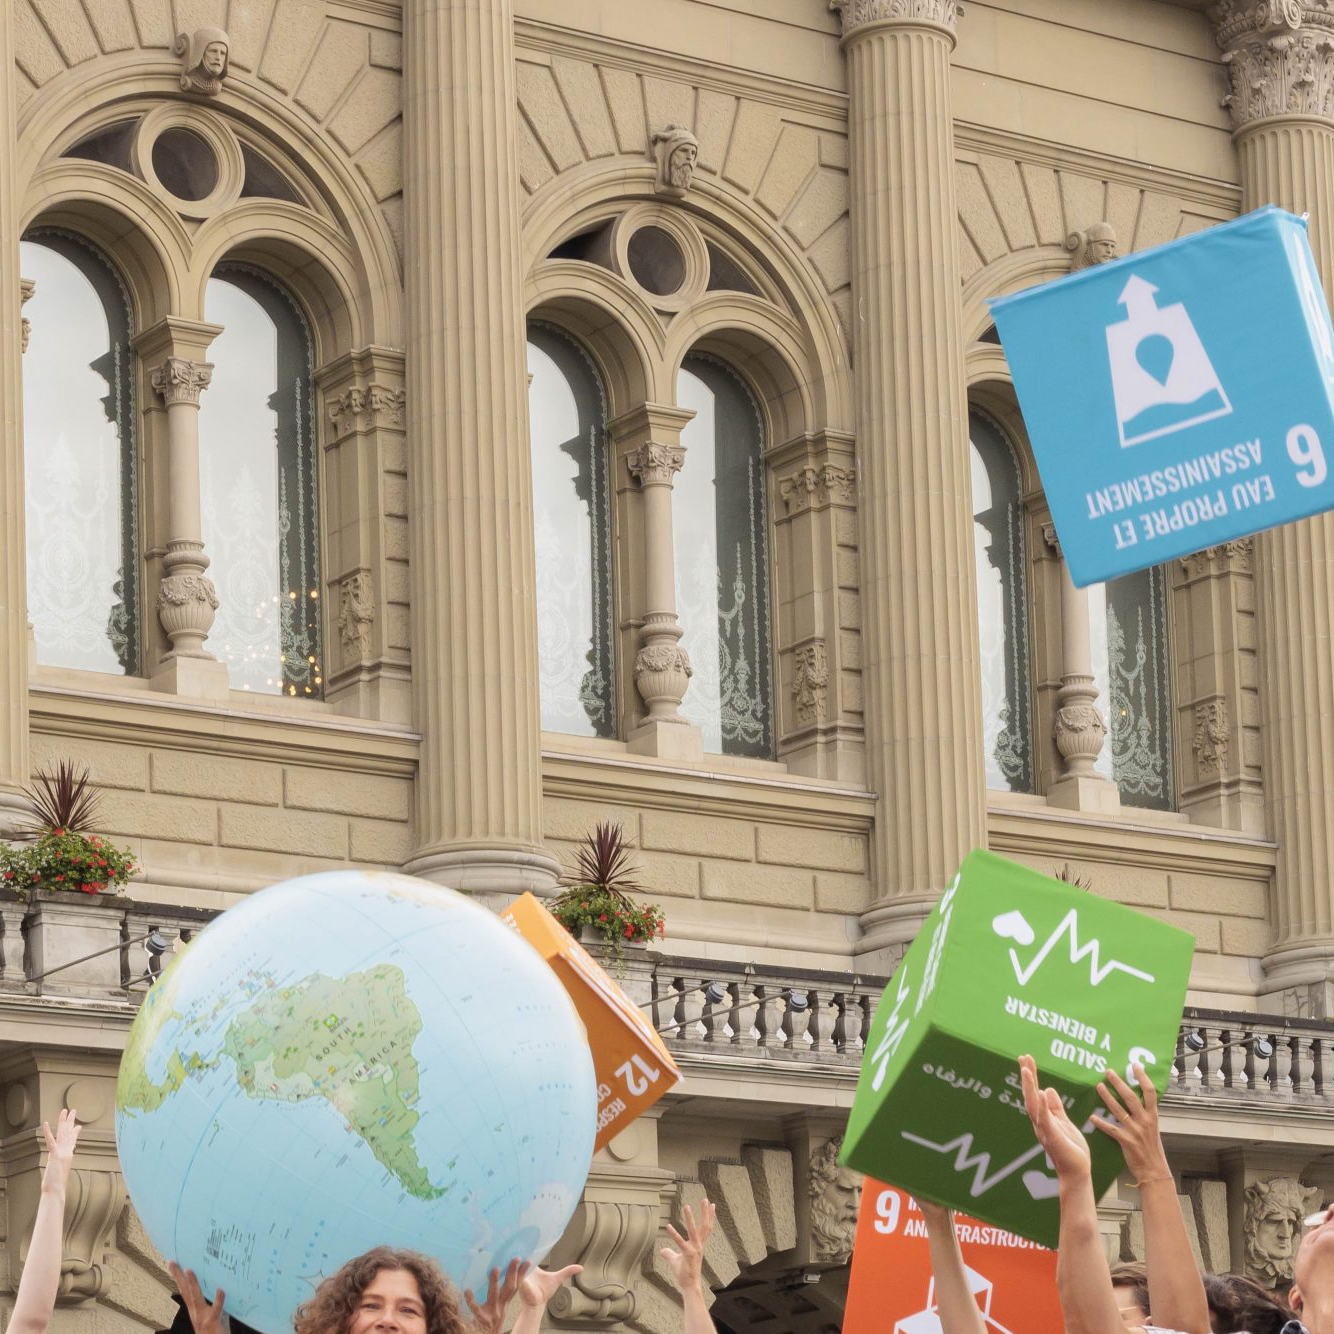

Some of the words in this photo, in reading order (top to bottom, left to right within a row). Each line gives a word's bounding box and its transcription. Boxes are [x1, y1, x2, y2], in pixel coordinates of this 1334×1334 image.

[1084, 437, 1263, 519] ASSAINISSEMENT
[1285, 423, 1328, 489] 6
[1140, 489, 1227, 539] PROPRE
[1232, 475, 1275, 511] EAU
[1113, 520, 1138, 549] ET
[1004, 994, 1097, 1043] BIENESTAR
[1050, 1038, 1107, 1075] SALUD
[1099, 1032, 1112, 1052] Y
[615, 1053, 660, 1097] 12
[1127, 1046, 1156, 1087] 3
[874, 1190, 901, 1234] 9
